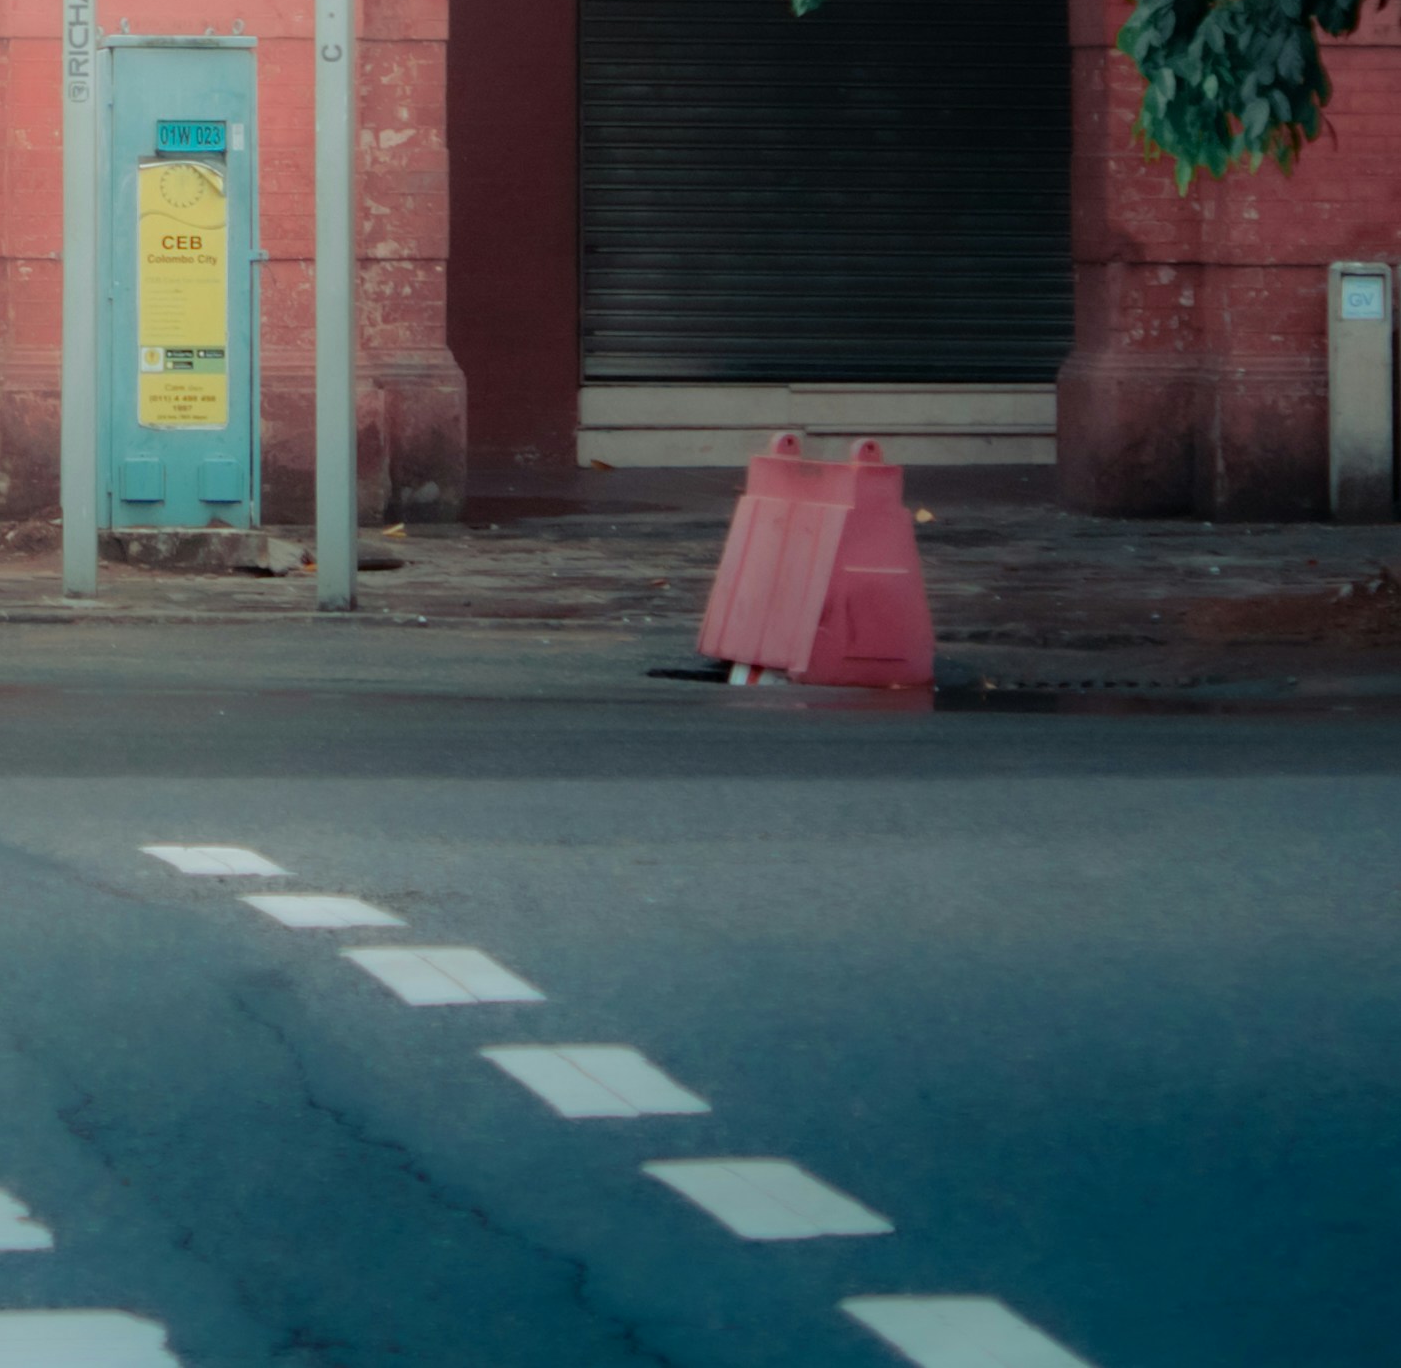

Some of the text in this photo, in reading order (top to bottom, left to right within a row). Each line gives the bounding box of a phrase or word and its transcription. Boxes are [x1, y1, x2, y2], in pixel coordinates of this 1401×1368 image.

[160, 125, 191, 145] 01W
[196, 126, 221, 145] 023
[161, 235, 203, 250] CEB
[147, 254, 218, 266] Colombo City
